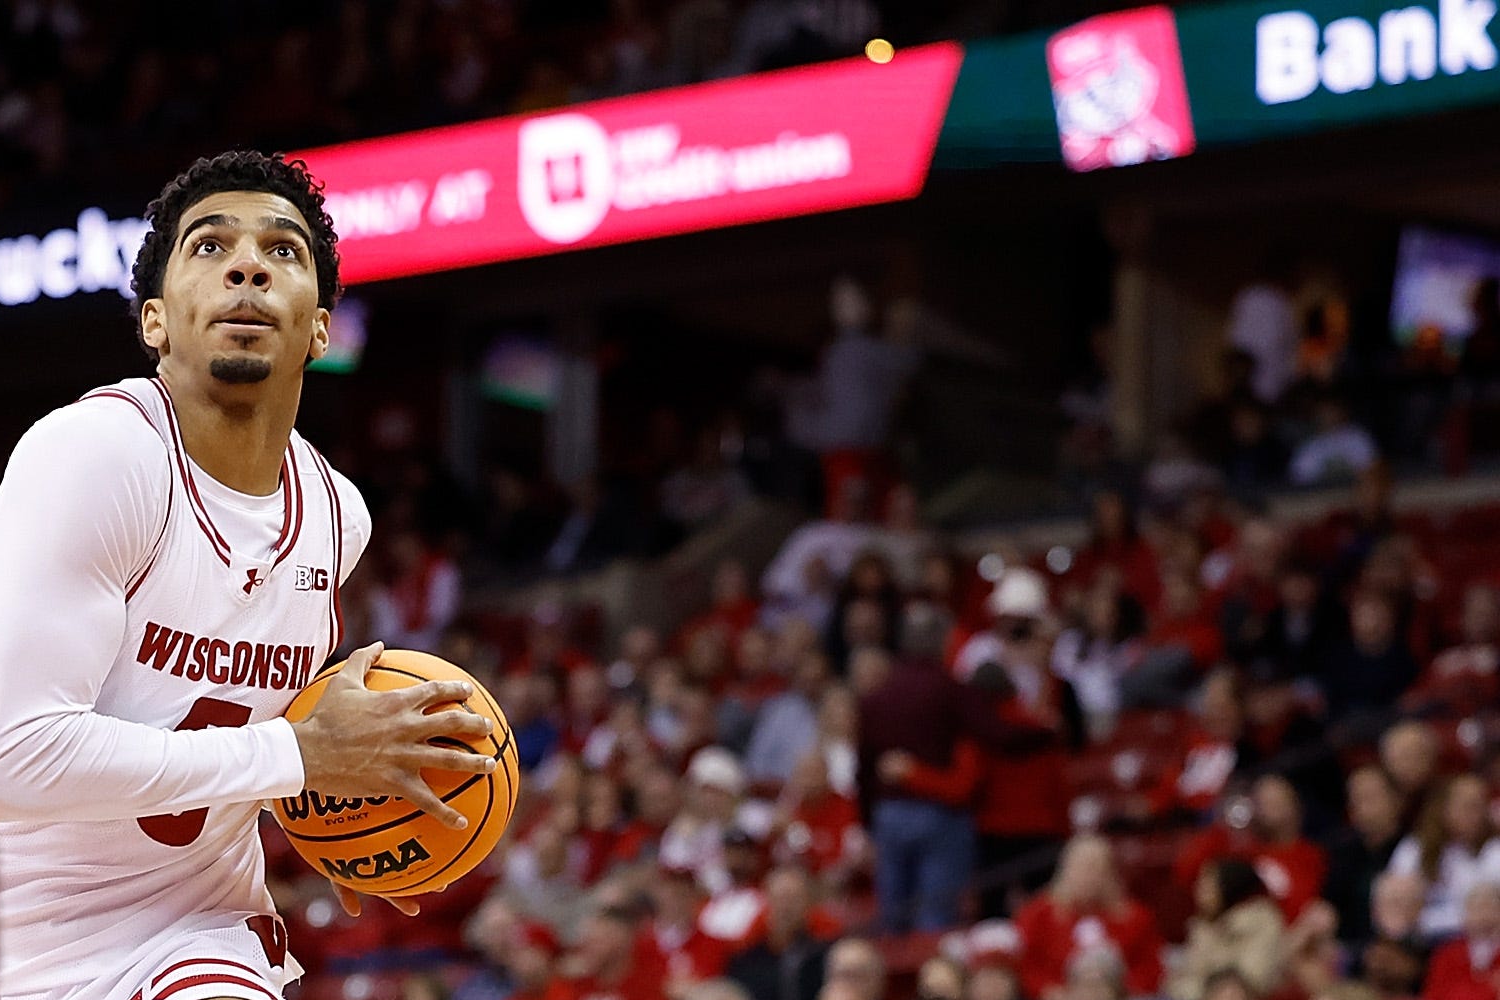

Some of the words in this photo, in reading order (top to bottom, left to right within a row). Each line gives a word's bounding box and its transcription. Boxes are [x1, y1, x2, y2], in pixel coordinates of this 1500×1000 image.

[1255, 0, 1498, 105] Bank
[136, 620, 315, 691] WISCONSIN
[319, 837, 432, 880] NCAA
